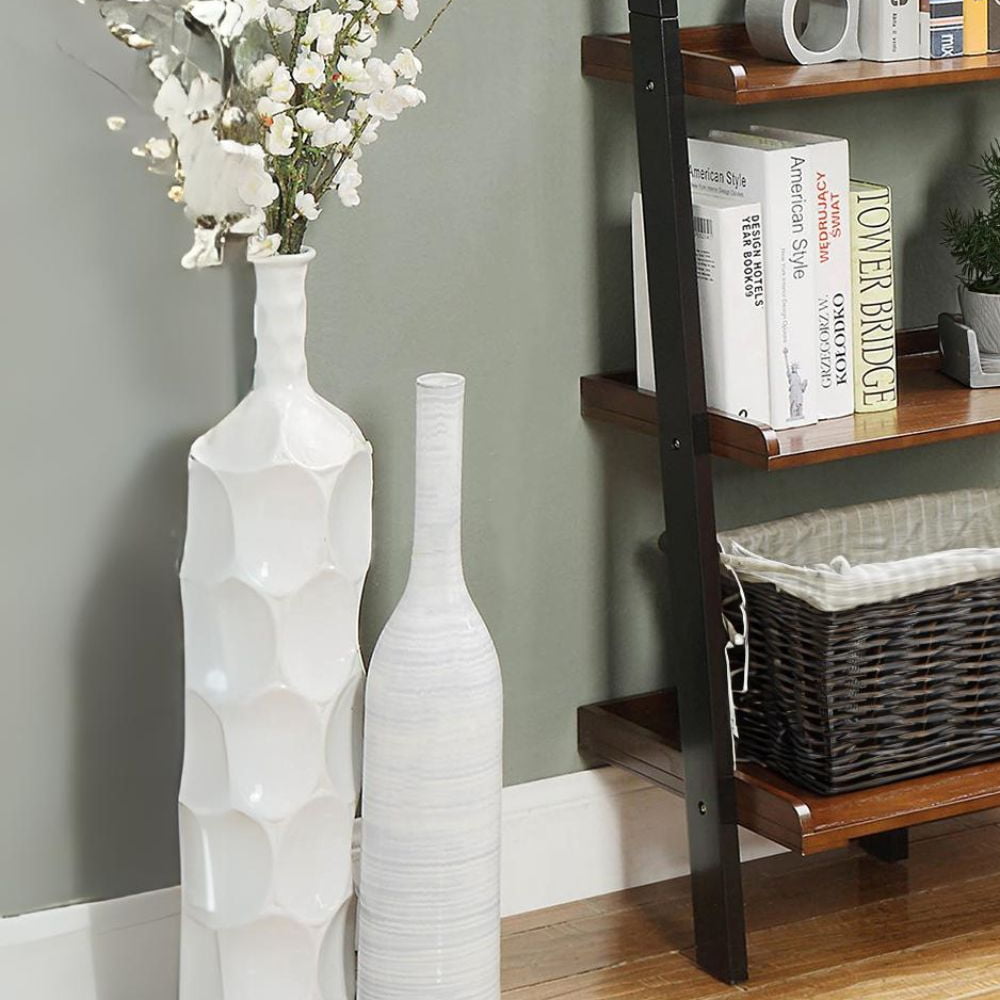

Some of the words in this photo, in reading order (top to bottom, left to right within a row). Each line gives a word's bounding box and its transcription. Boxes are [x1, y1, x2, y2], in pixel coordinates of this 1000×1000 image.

[941, 33, 955, 57] mix
[726, 171, 747, 189] Style
[790, 156, 806, 234] American
[742, 216, 752, 247] YEAR
[751, 214, 762, 257] DESIGN
[816, 171, 831, 264] WĘDRUJĄCY
[830, 193, 841, 238] ŚWIAT
[788, 238, 808, 280] Style
[856, 192, 893, 294] TOWER
[753, 262, 764, 307] HOTELS
[819, 313, 832, 389] GRZEGORZ
[832, 292, 848, 385] KOŁODKO
[860, 298, 896, 406] BRIDGE
